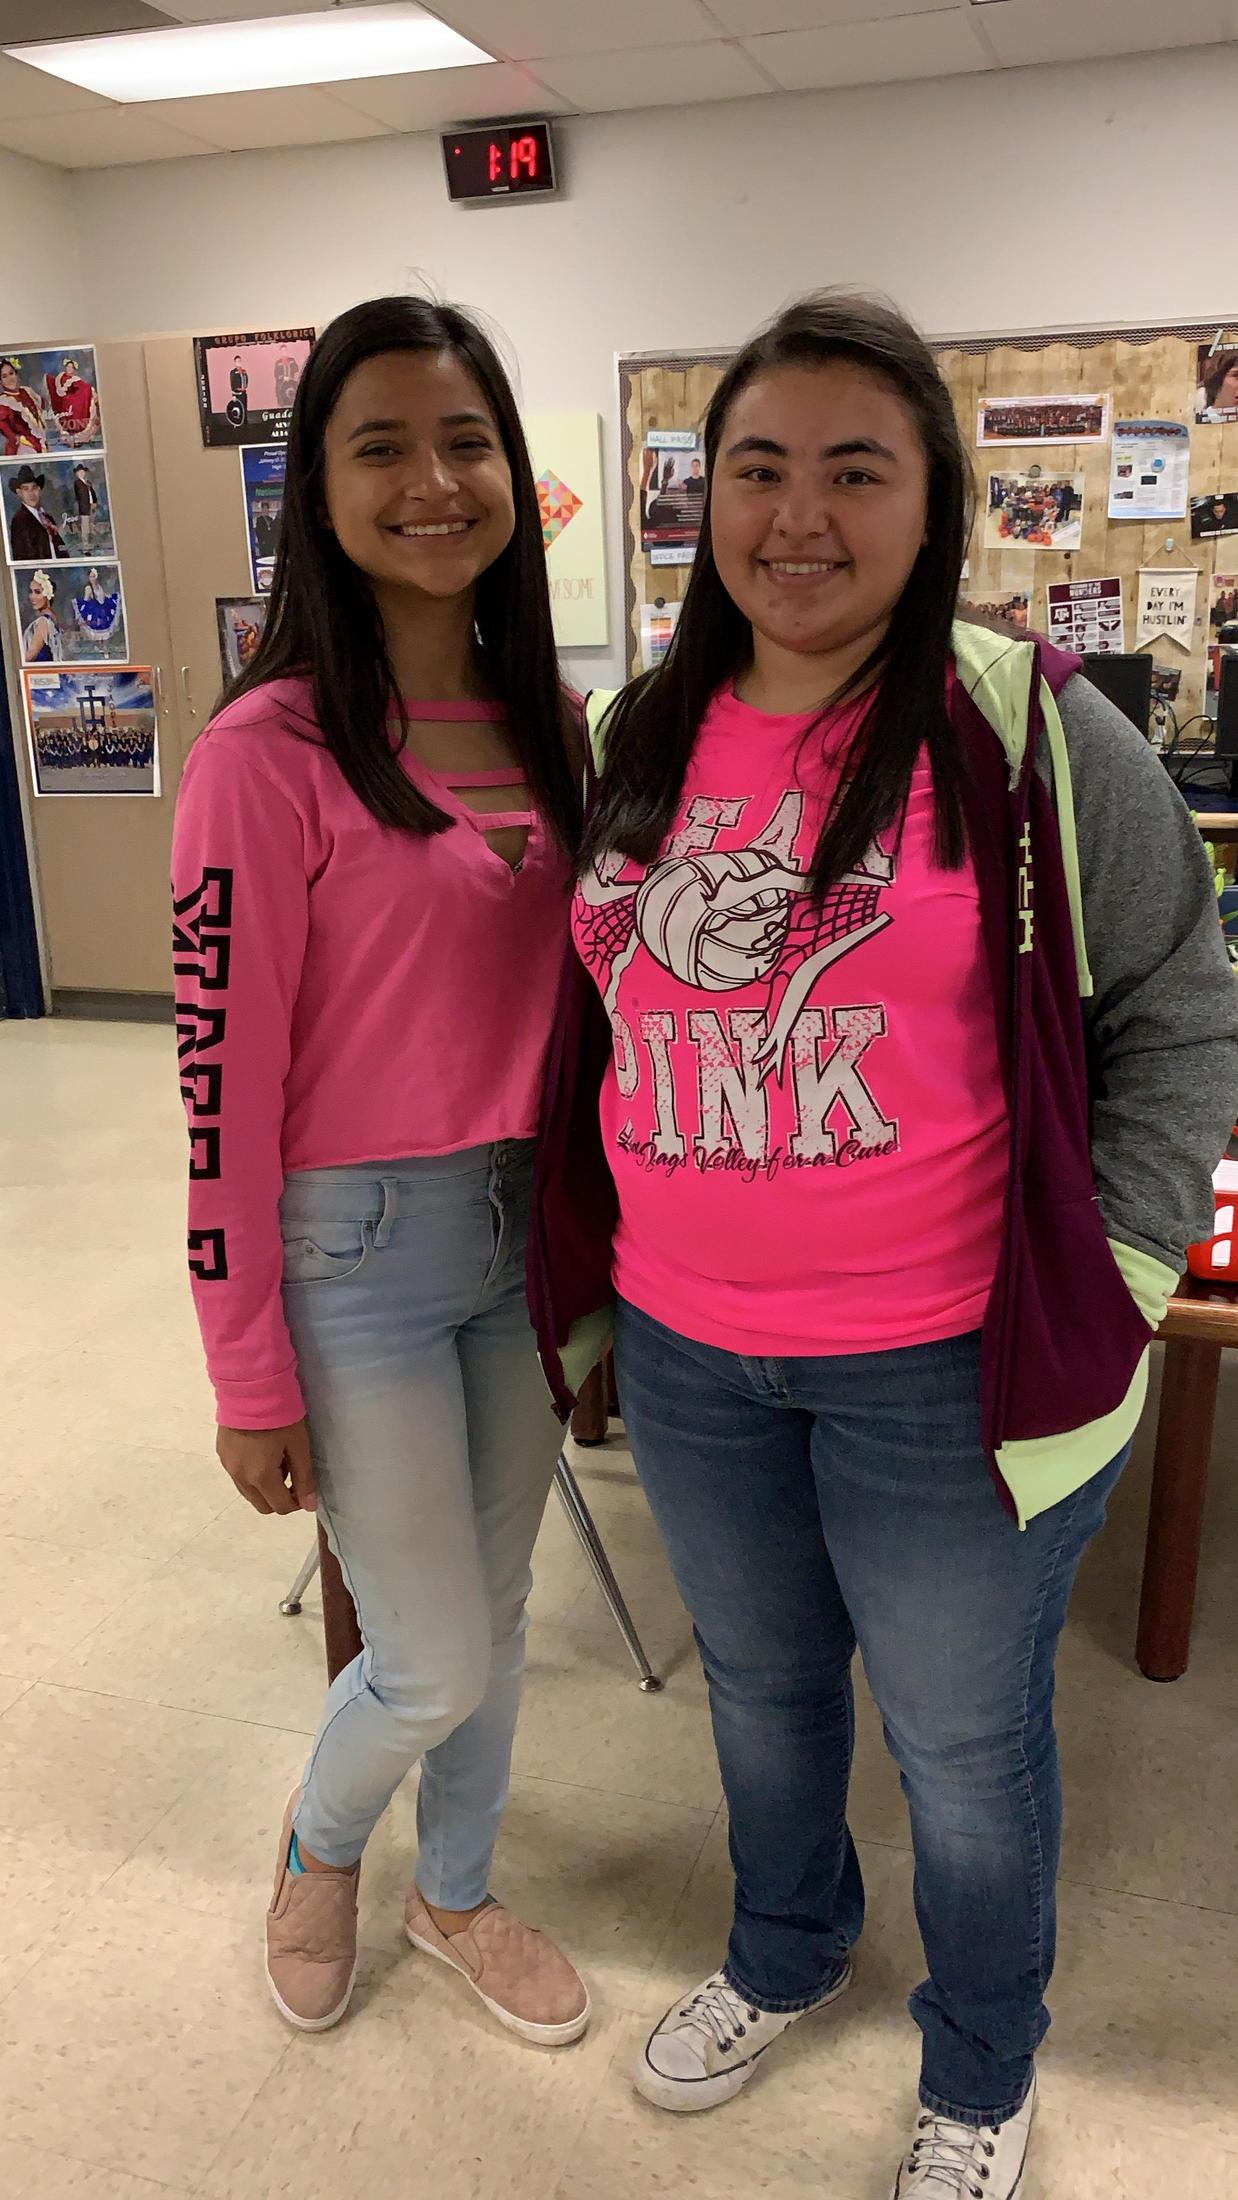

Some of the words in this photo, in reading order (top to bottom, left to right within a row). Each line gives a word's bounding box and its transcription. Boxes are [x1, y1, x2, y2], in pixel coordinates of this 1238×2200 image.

[489, 136, 537, 180] 1:19
[215, 335, 247, 345] GRUPO
[255, 329, 314, 341] FOLKLORICO
[549, 577, 597, 601] ESOME
[1150, 587, 1180, 597] EVERY
[1147, 601, 1164, 611] DAY
[1169, 601, 1184, 611] I'M
[1142, 615, 1187, 625] HUSTLIN'
[692, 1145, 761, 1183] Volley
[835, 1140, 898, 1168] Cure
